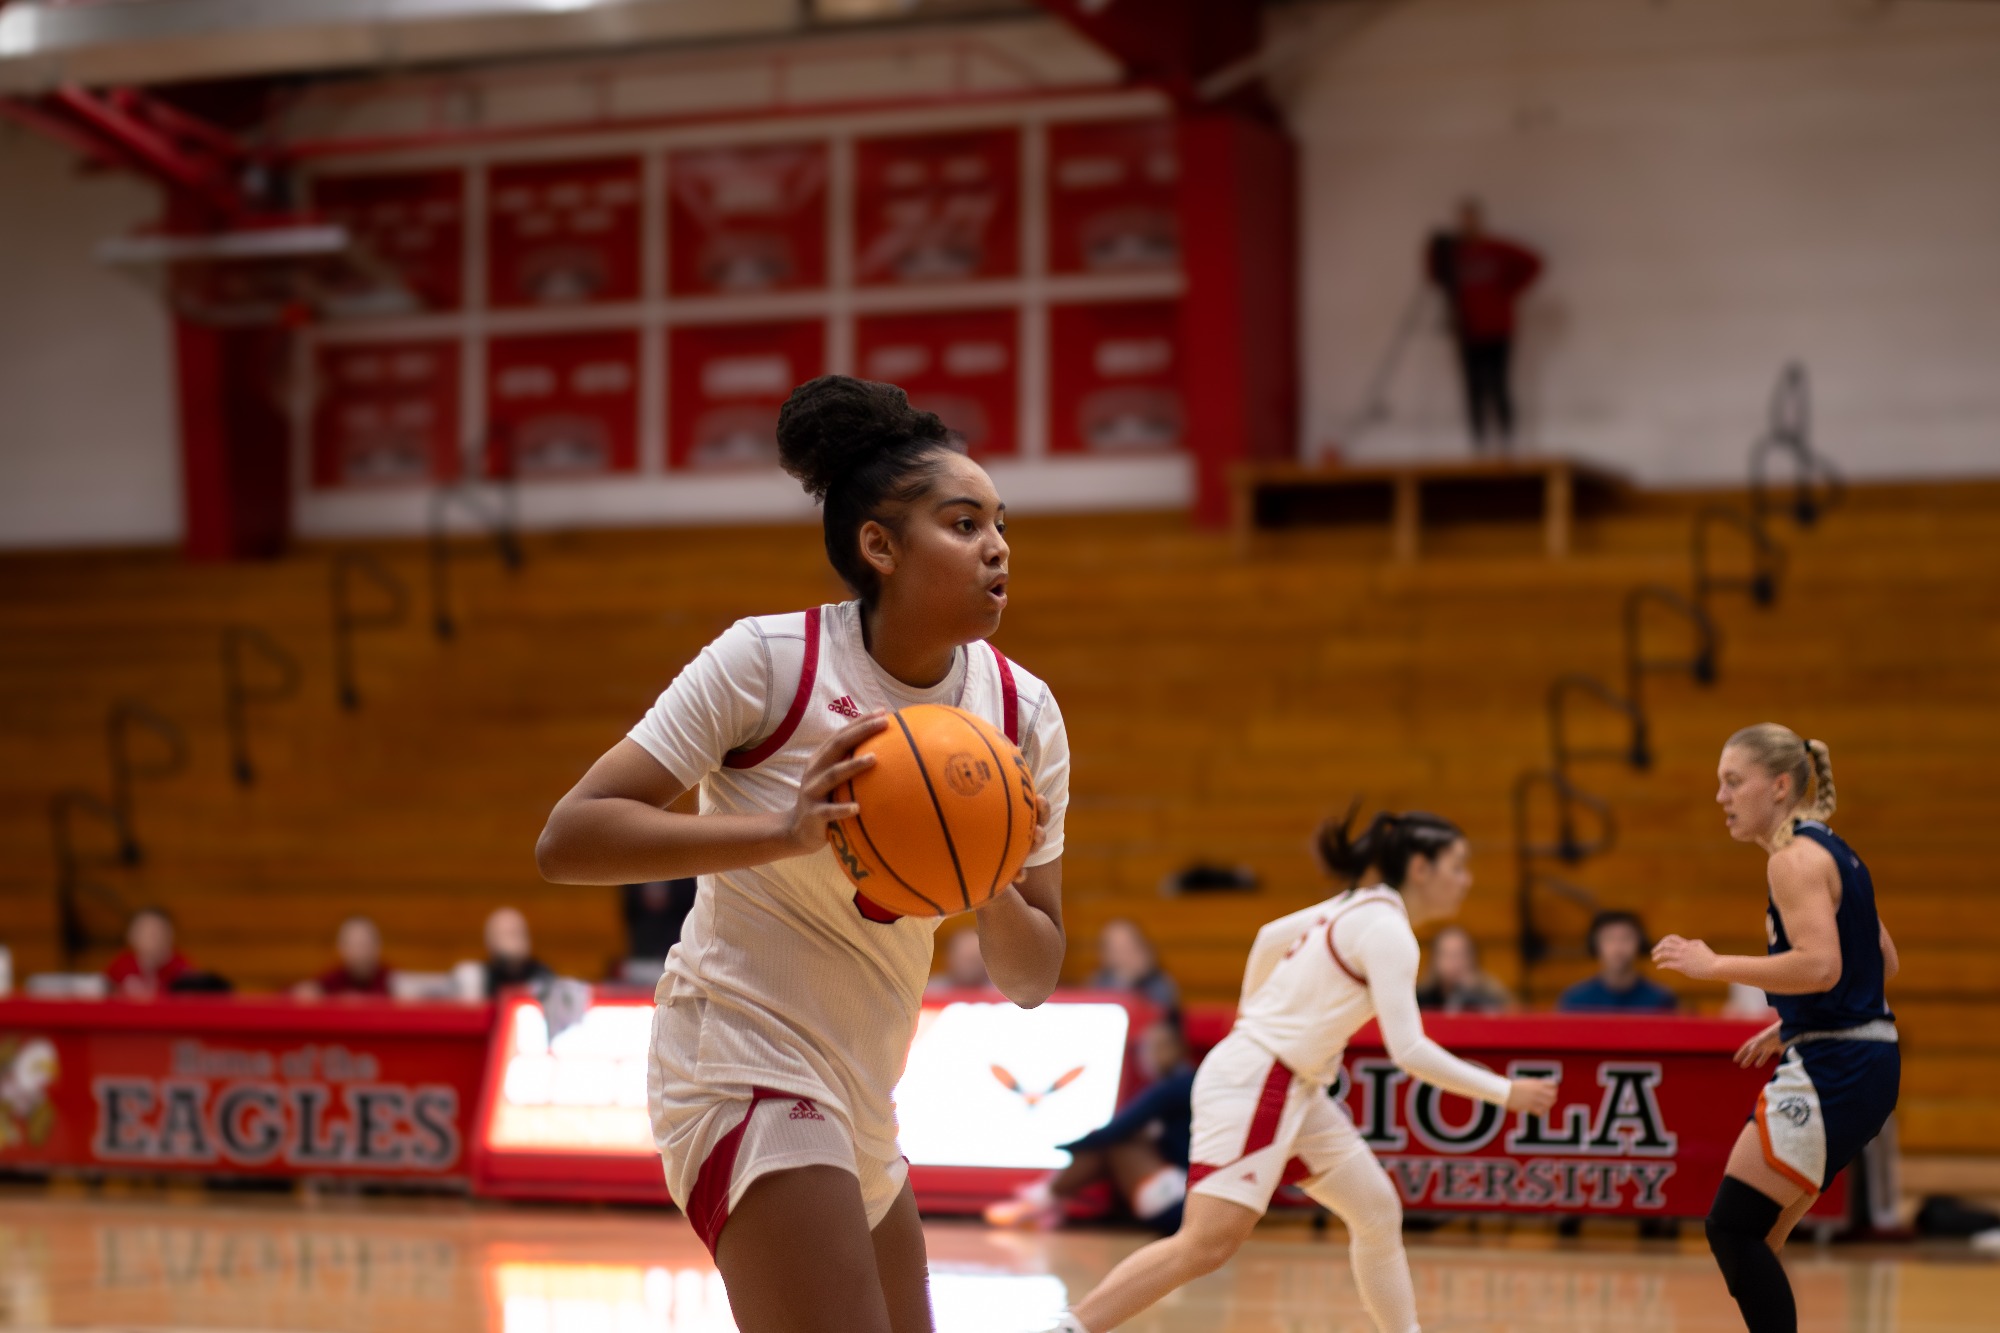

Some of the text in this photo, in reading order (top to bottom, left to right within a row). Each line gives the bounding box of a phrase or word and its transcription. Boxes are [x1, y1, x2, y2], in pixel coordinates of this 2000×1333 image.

[95, 1079, 458, 1168] EAGLES
[788, 1110, 825, 1121] adidas
[1327, 1059, 1676, 1156] IOLA
[1378, 1157, 1675, 1207] VERSITY
